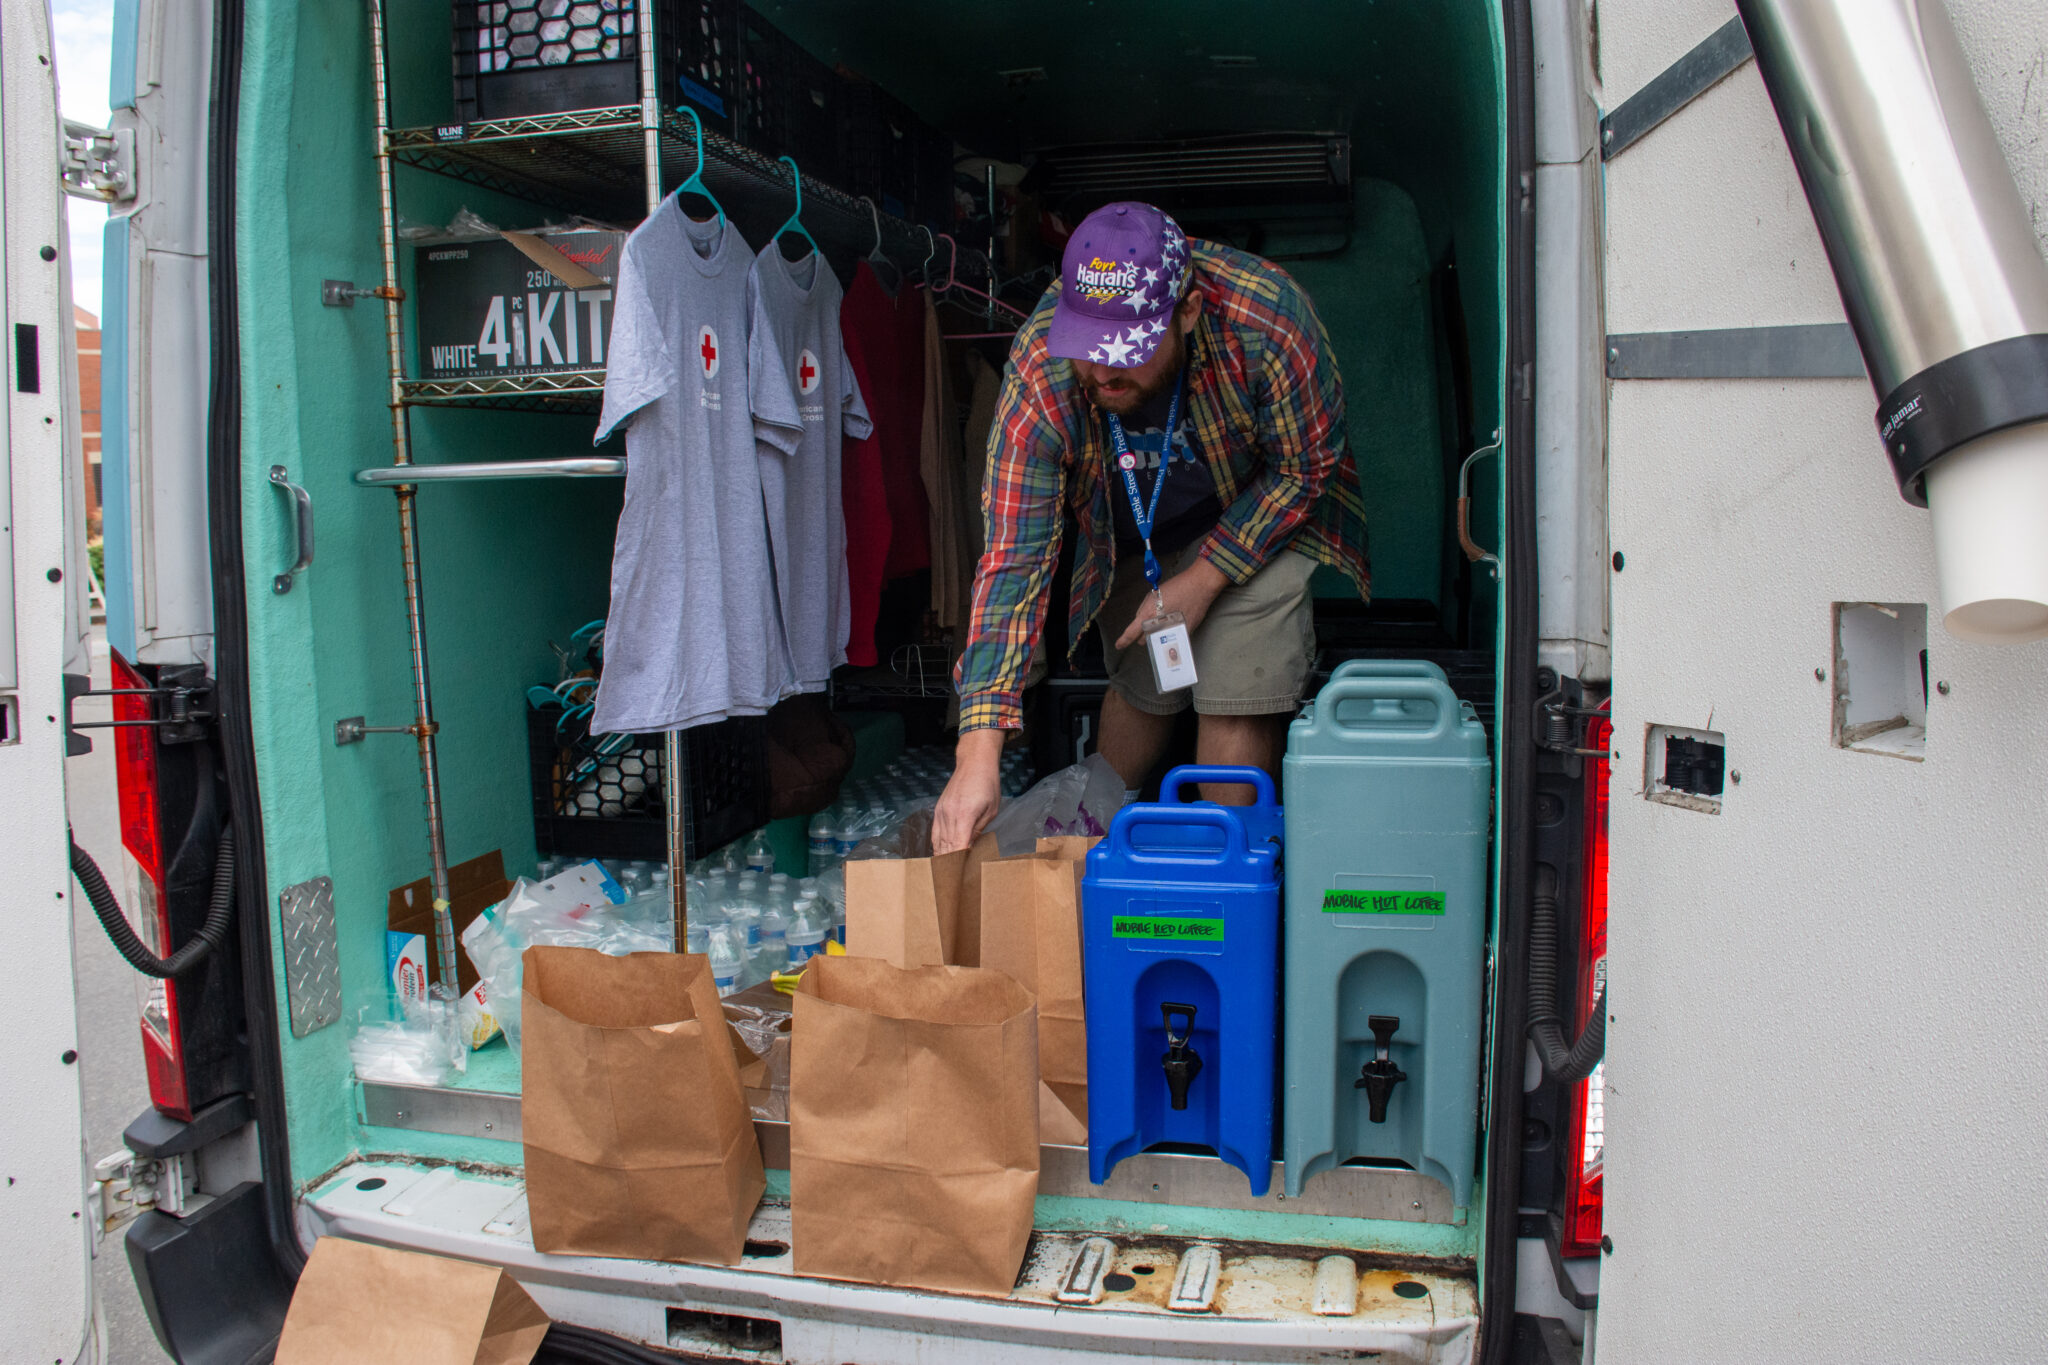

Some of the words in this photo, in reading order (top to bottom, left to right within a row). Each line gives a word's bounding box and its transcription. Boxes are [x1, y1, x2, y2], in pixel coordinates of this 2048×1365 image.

[438, 126, 464, 137] ULINE
[1090, 257, 1117, 272] Foyt
[526, 270, 551, 288] 250
[512, 297, 523, 310] PC
[431, 345, 477, 370] WHITE
[478, 295, 511, 367] 4
[527, 289, 612, 366] KIT
[469, 369, 494, 377] KNIFE
[508, 367, 554, 375] TEASPOON
[1890, 397, 1920, 429] jamar
[1113, 423, 1127, 453] Preble
[1132, 496, 1145, 526] Preble
[1323, 894, 1369, 909] MOBILE
[1373, 896, 1401, 911] HOT
[1405, 896, 1443, 911] COFFEE
[1115, 922, 1151, 934] MOBILE
[1154, 923, 1176, 935] ICED
[1178, 923, 1217, 936] COFFEE
